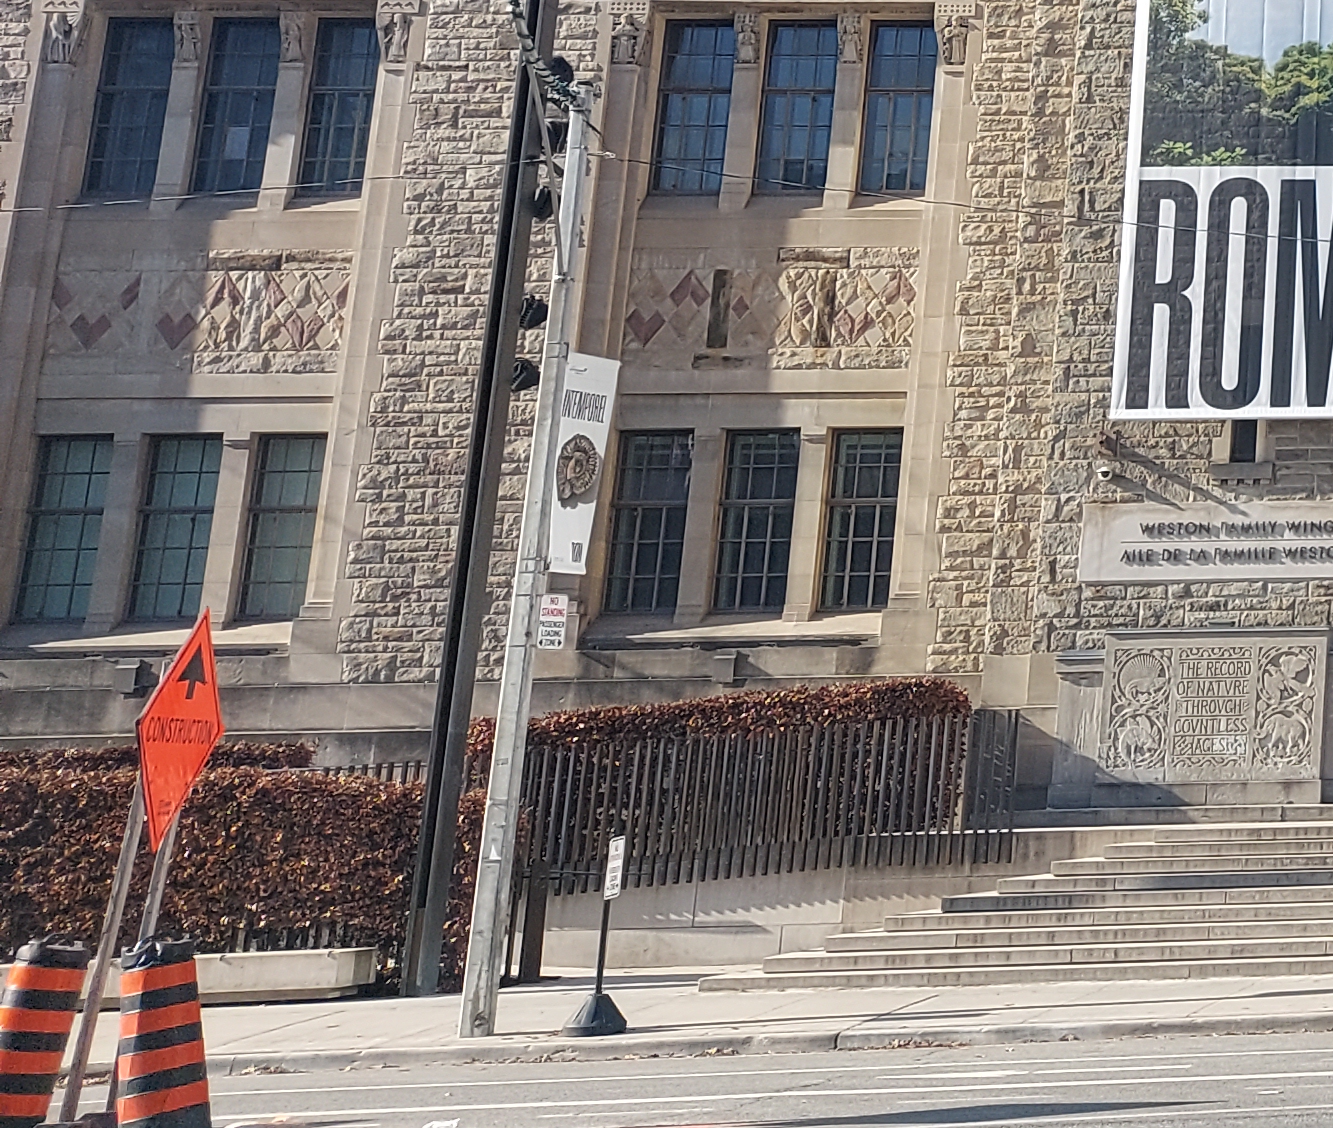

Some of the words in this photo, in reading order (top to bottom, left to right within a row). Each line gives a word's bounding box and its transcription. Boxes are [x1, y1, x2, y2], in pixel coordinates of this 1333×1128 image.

[1140, 521, 1211, 535] WESTON
[1221, 521, 1278, 534] FAMILY
[1162, 548, 1180, 561] DE
[1189, 548, 1207, 561] LA
[541, 607, 566, 617] STANDING
[1179, 661, 1203, 678] THE
[1206, 660, 1252, 677] RECORD
[1176, 680, 1194, 696] OF
[146, 716, 214, 745] CONSTRUCTION
[1194, 738, 1226, 753] AGES
